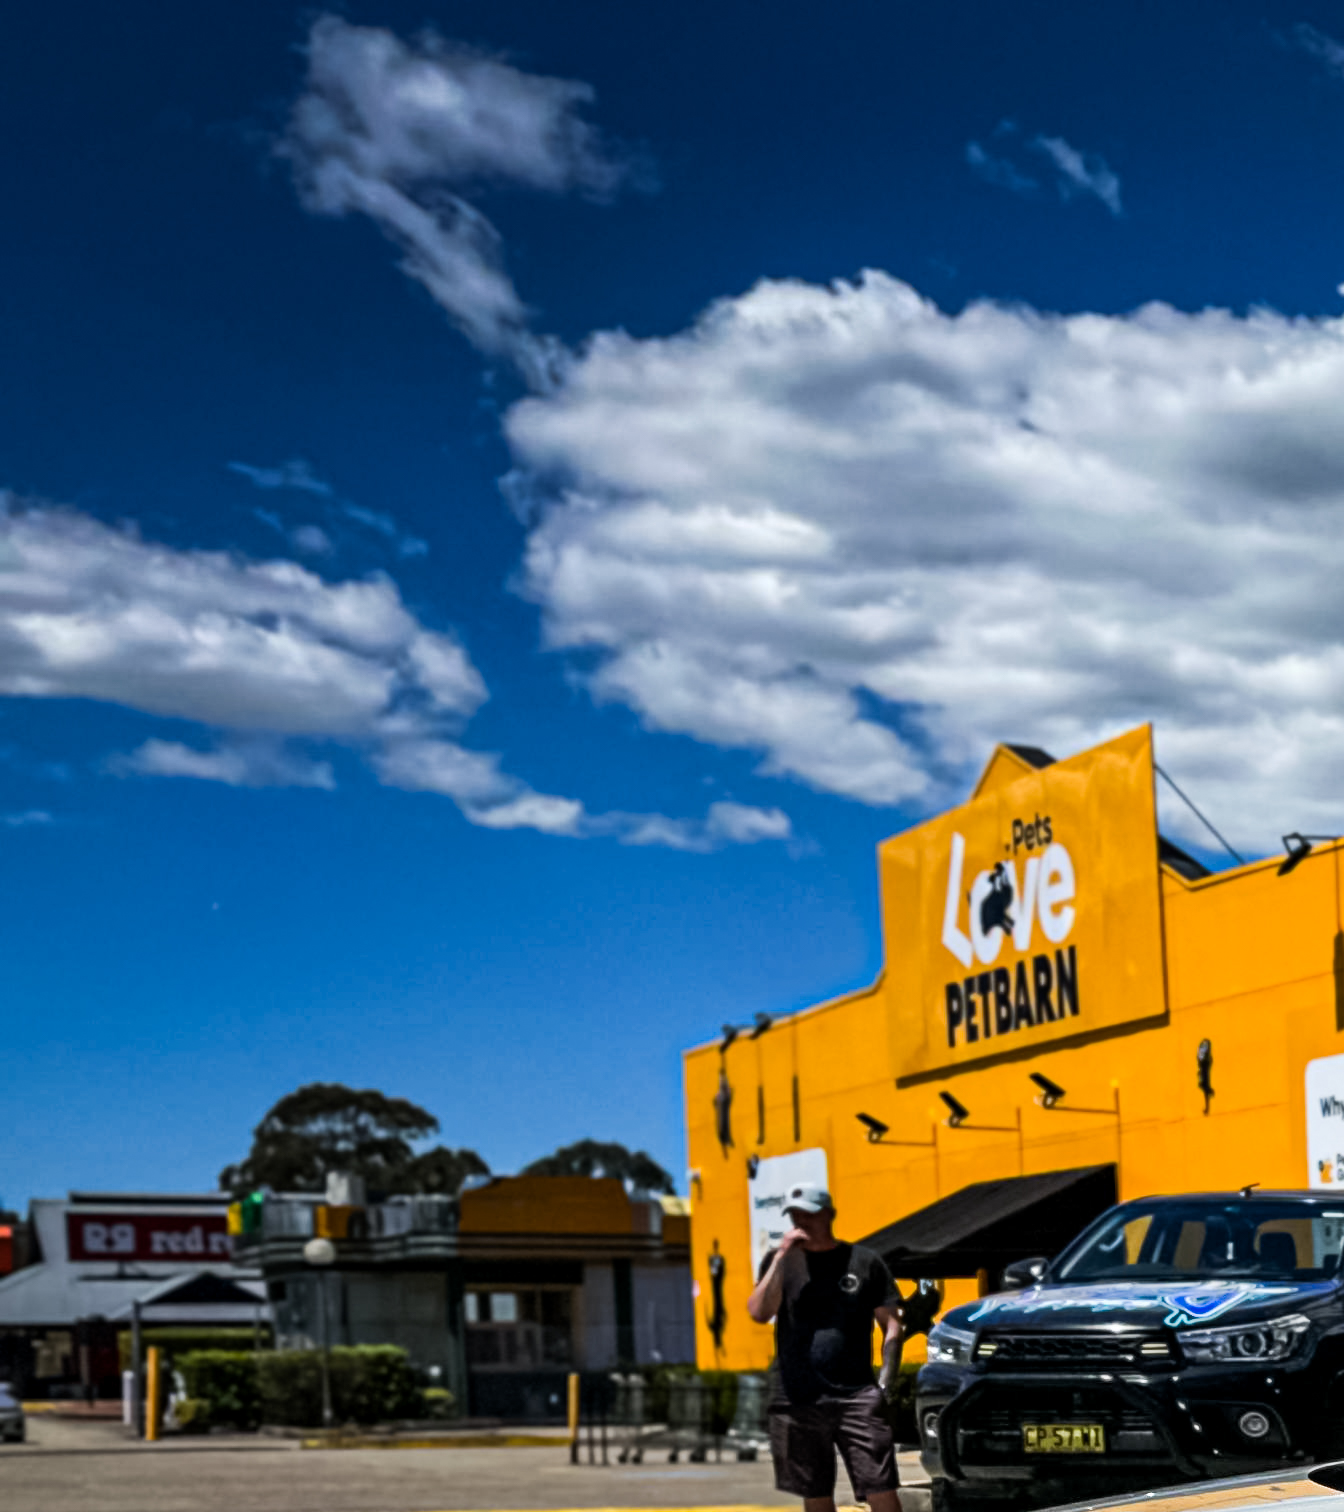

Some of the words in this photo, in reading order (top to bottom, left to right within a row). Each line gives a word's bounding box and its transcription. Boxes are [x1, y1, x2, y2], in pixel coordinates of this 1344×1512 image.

[1011, 812, 1054, 856] Pets
[941, 831, 1076, 970] Love
[945, 945, 1080, 1049] PETBARN
[151, 1225, 204, 1254] red
